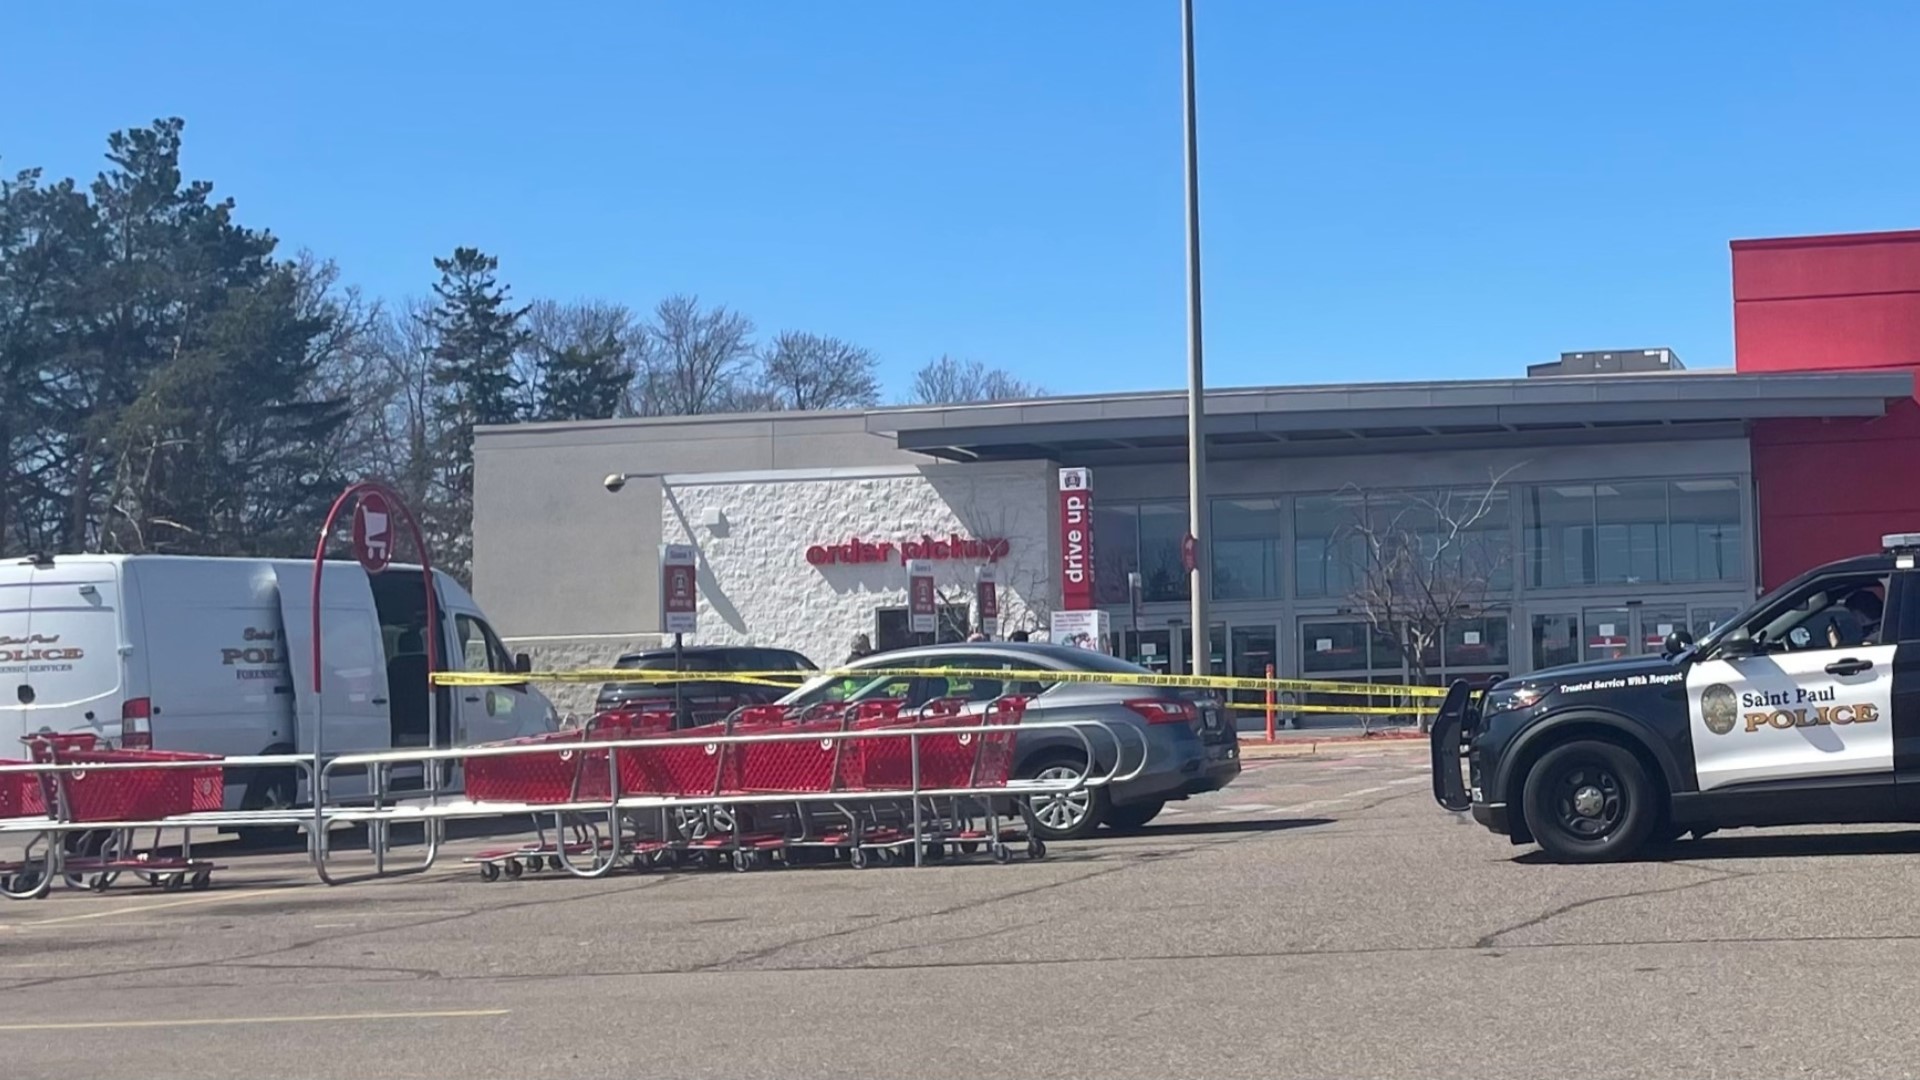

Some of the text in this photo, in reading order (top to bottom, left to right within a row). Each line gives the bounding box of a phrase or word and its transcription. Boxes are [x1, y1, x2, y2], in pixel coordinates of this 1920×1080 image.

[806, 533, 1009, 566] order pickup
[1064, 496, 1085, 583] drive up
[0, 647, 84, 662] OLICE
[221, 648, 286, 665] POL
[1560, 672, 1683, 693] Trusted Service With Respect
[1742, 690, 1790, 708] Saint
[1796, 686, 1836, 704] Paul
[1744, 703, 1879, 732] POLICE
